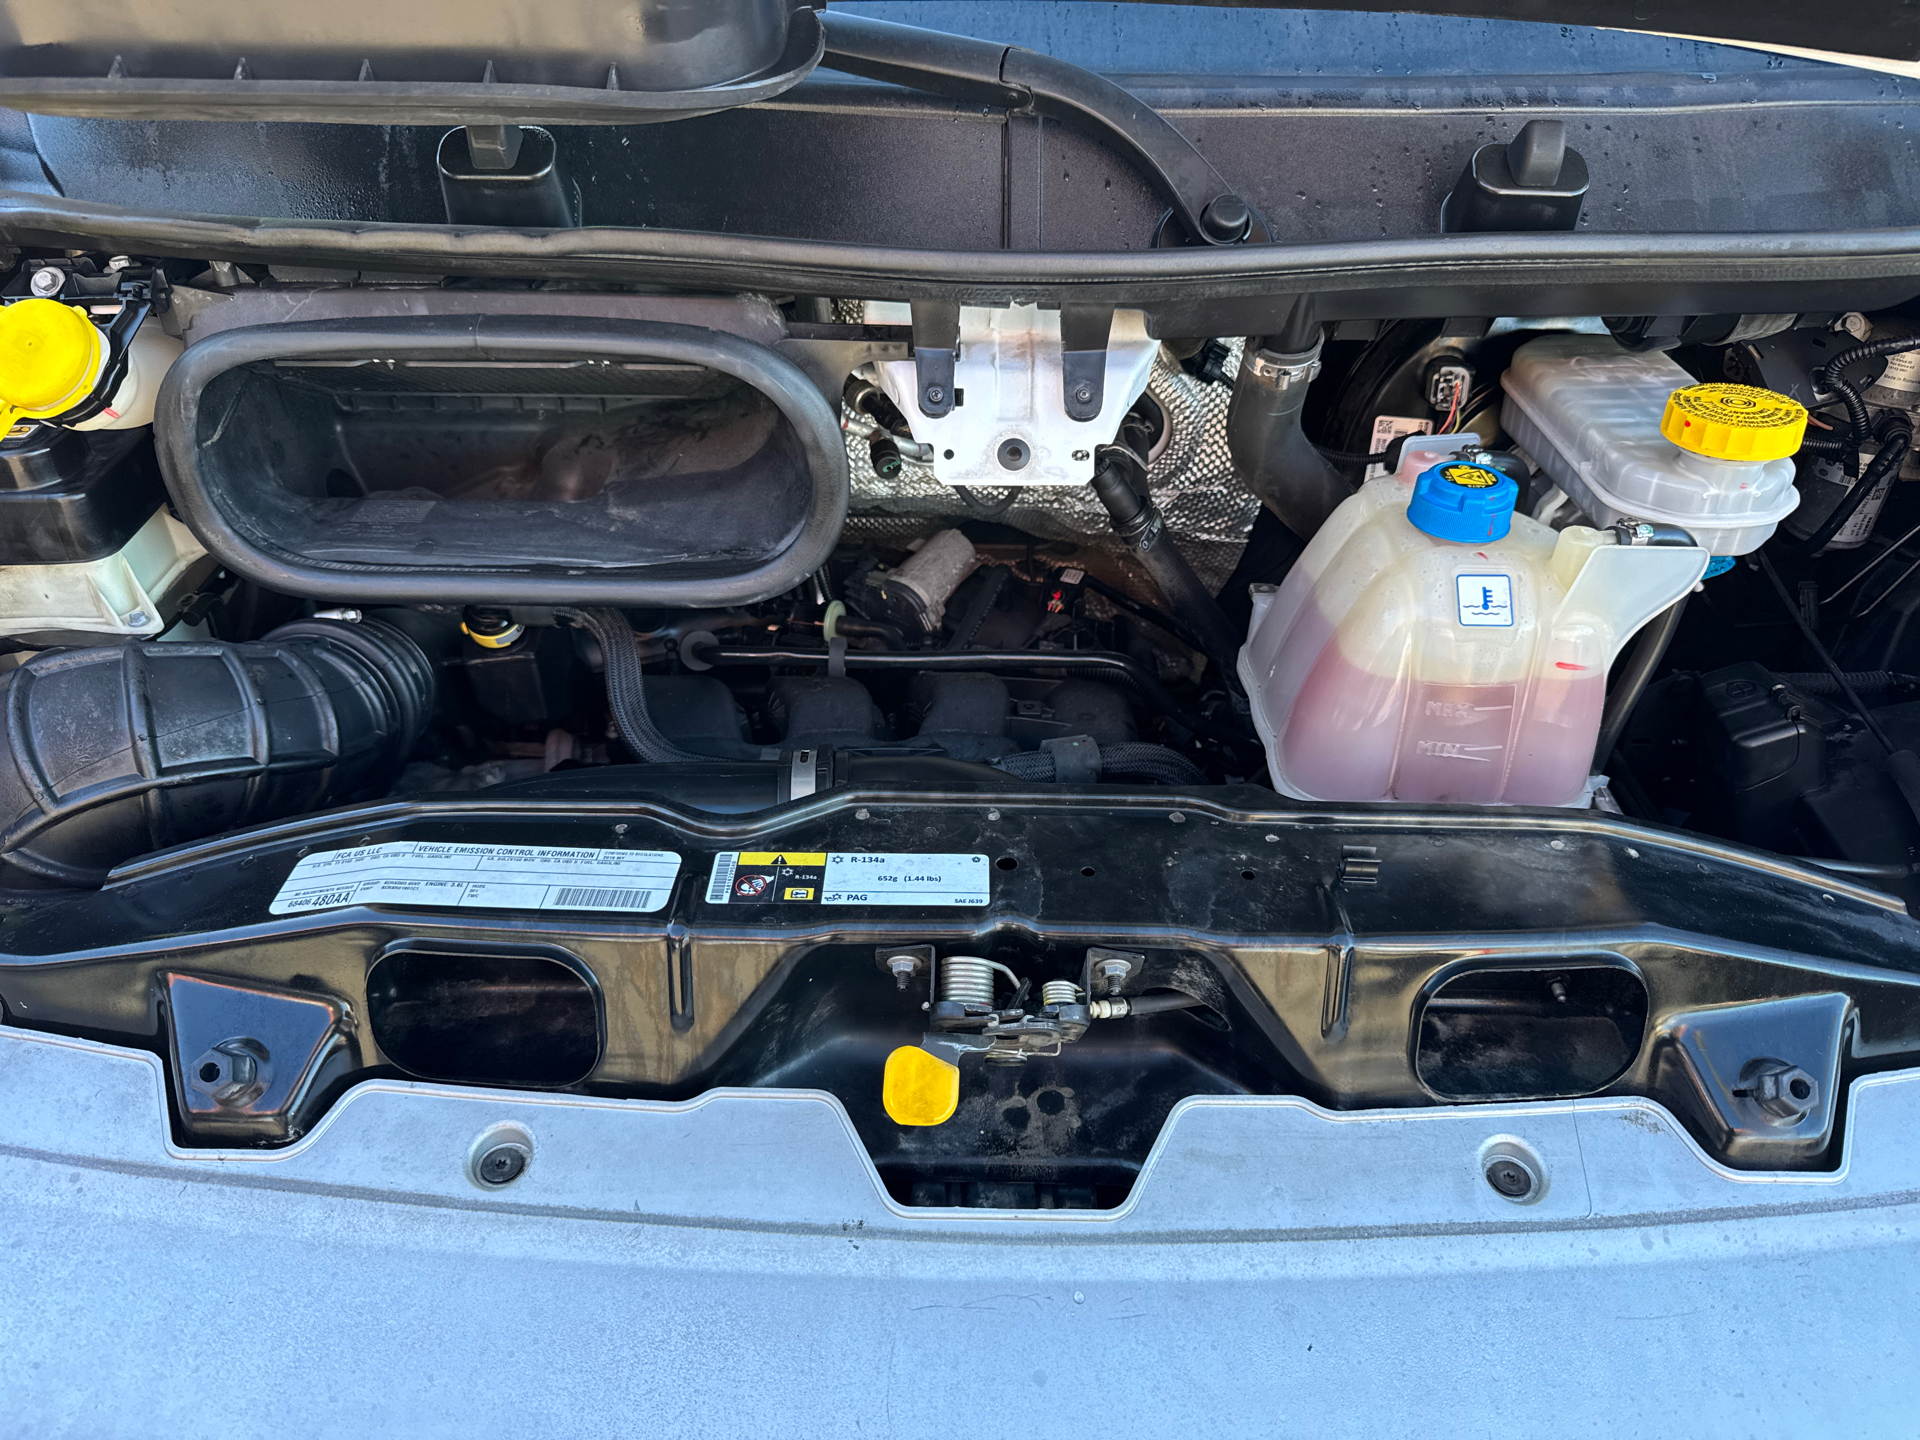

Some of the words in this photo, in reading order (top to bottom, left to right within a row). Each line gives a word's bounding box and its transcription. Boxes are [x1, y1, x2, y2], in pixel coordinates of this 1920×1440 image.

[1416, 741, 1460, 757] MIN
[336, 851, 352, 860] FCA
[354, 849, 366, 857] US
[367, 847, 383, 855] LLC
[418, 845, 453, 853] VEHICLE
[453, 846, 495, 855] EMISSION
[496, 848, 535, 857] CONTROL
[537, 850, 596, 859] INFORMATION
[850, 856, 885, 864] R-134a
[903, 875, 925, 883] (1.44
[926, 875, 942, 883] lbs)
[312, 892, 351, 907] 480AA
